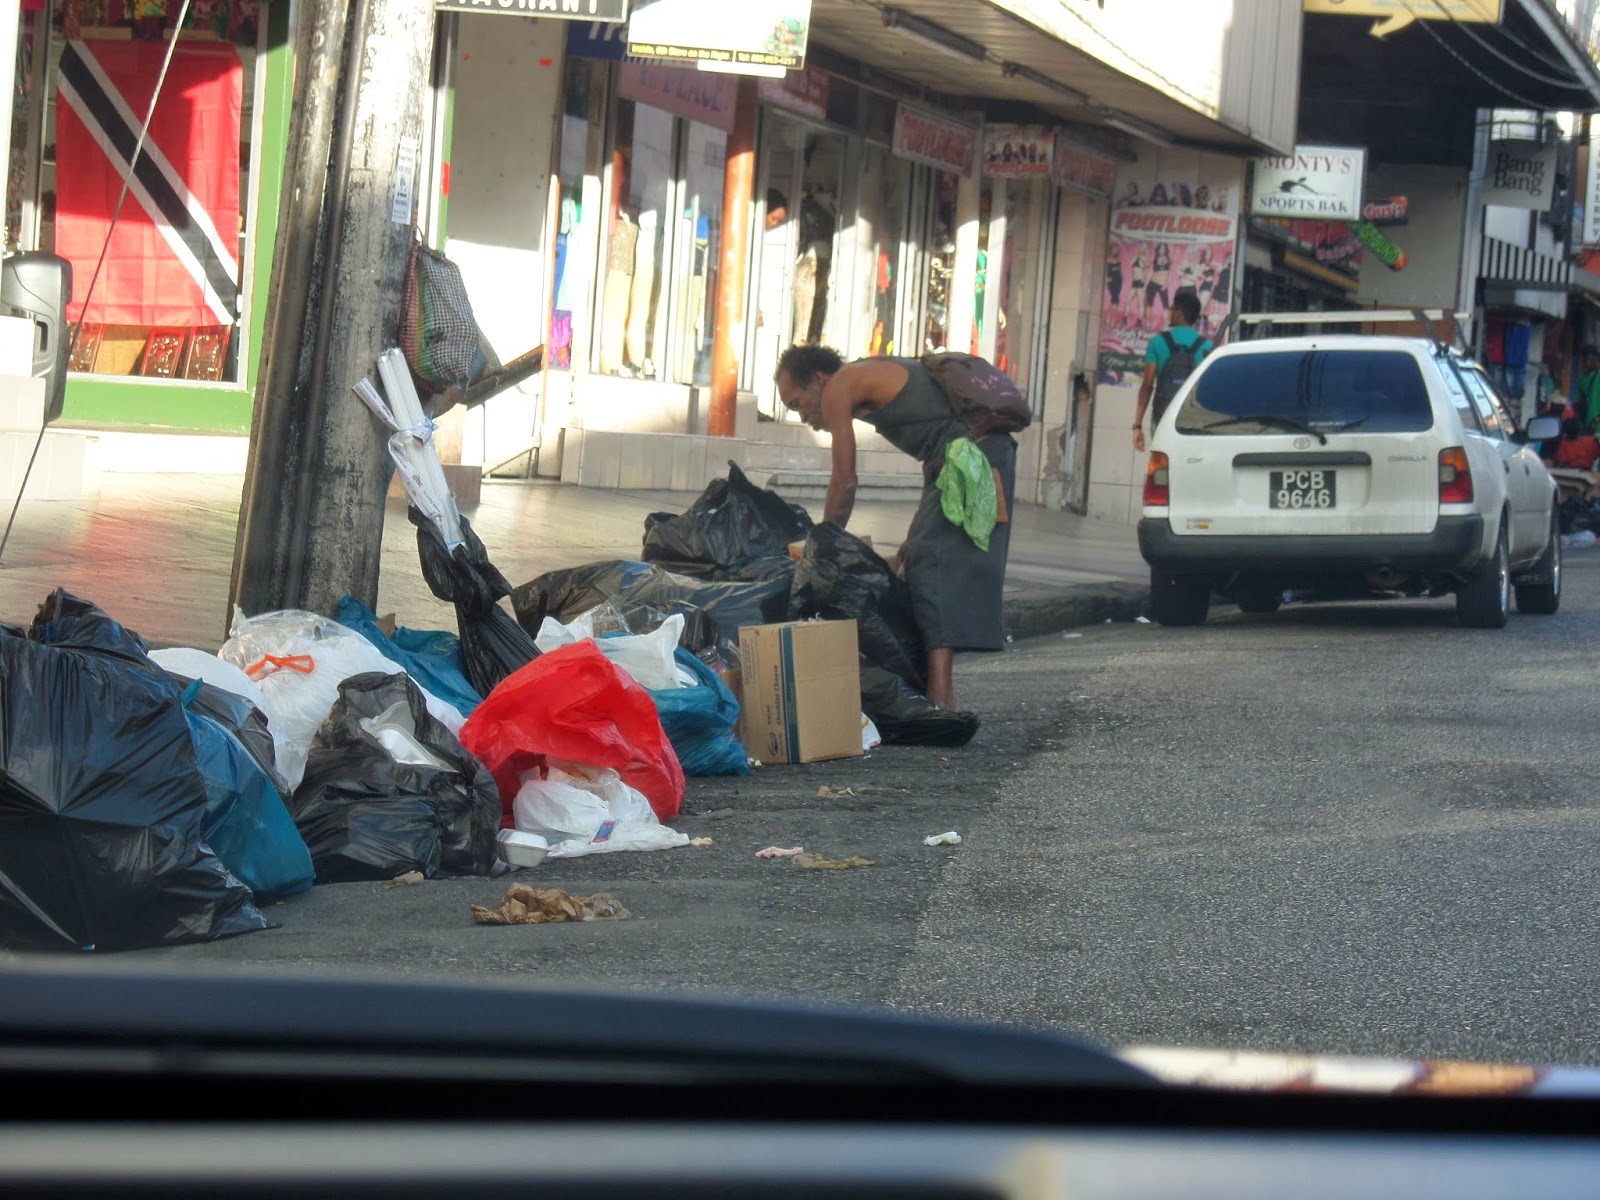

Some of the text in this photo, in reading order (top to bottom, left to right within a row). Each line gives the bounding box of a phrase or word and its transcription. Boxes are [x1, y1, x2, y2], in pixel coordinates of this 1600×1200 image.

[1264, 155, 1351, 174] MONTY'S
[1494, 153, 1545, 177] Bang
[1492, 169, 1543, 197] Bang
[1260, 198, 1315, 211] SPORTS
[1115, 211, 1231, 237] FOOTLOOSE
[1282, 471, 1325, 490] PCB
[1276, 489, 1331, 509] 9646
